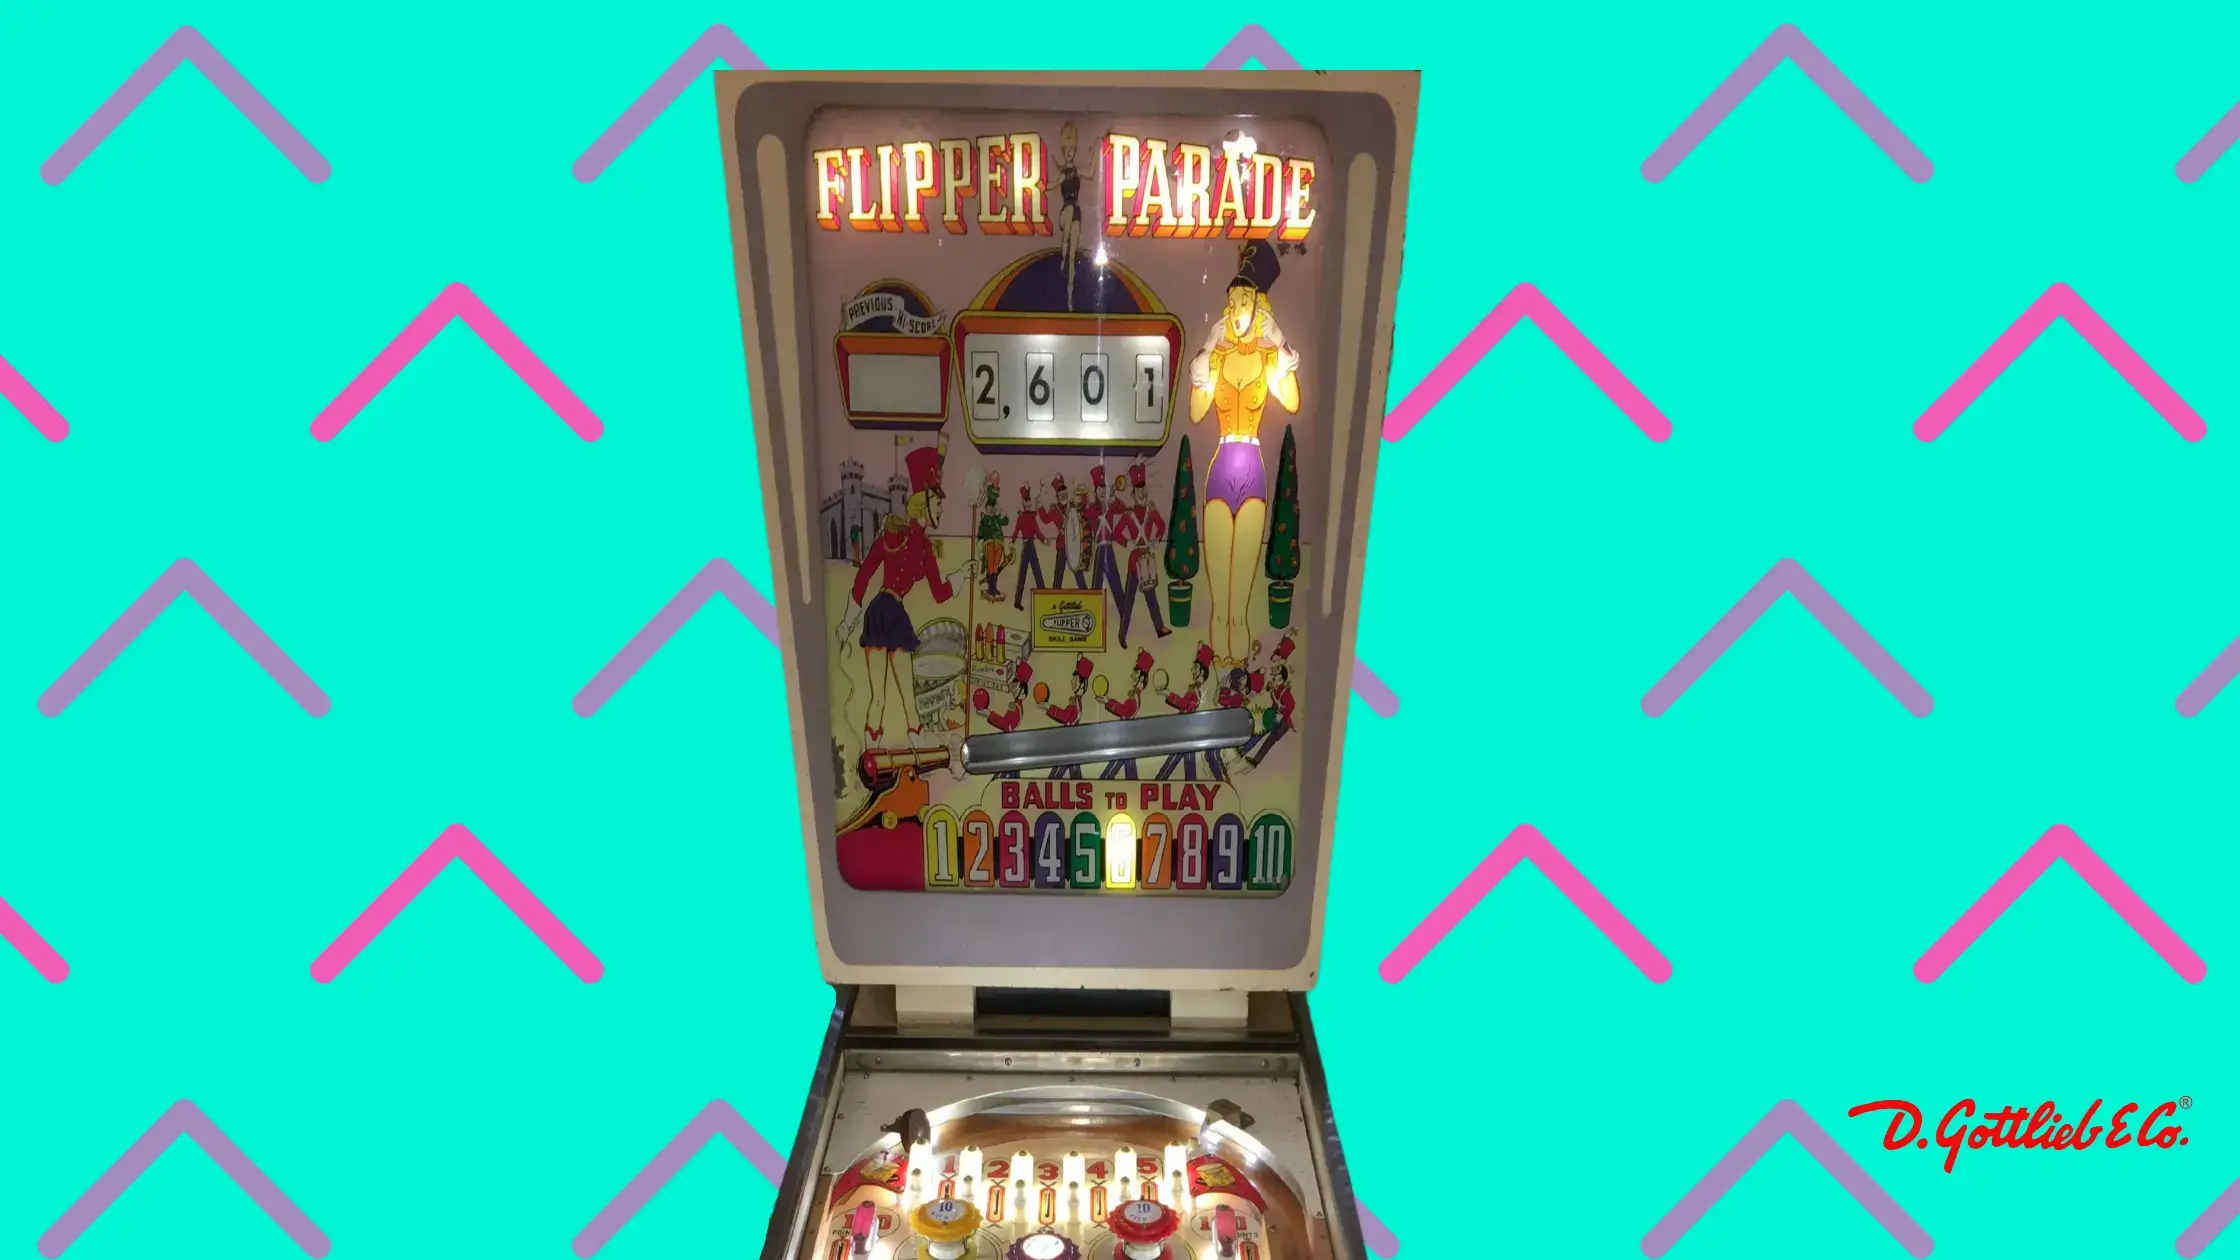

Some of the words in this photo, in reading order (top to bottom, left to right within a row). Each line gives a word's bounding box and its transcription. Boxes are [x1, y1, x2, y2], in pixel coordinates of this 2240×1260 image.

[813, 132, 1053, 236] FLIPPER
[1102, 132, 1316, 241] PARADE
[848, 297, 893, 321] PREVIOUS
[1001, 781, 1094, 811] BALLS
[1105, 792, 1127, 811] TO
[1140, 783, 1221, 812] PLAY
[933, 821, 953, 881] 1
[967, 821, 989, 882] 2
[1004, 822, 1026, 883] 3
[1038, 822, 1061, 883] 4
[1075, 823, 1096, 884] 5
[1109, 822, 1132, 884] 6
[1146, 823, 1167, 884] 7
[1182, 824, 1203, 884] 8
[1217, 824, 1238, 884] 9
[1252, 824, 1285, 884] 10
[943, 1155, 957, 1173] 1
[987, 1160, 1010, 1178] 2
[1038, 1162, 1059, 1180] 3
[1086, 1161, 1108, 1179] 4
[1137, 1157, 1158, 1174] 5
[939, 1201, 953, 1212] 10
[1136, 1202, 1150, 1214] 10
